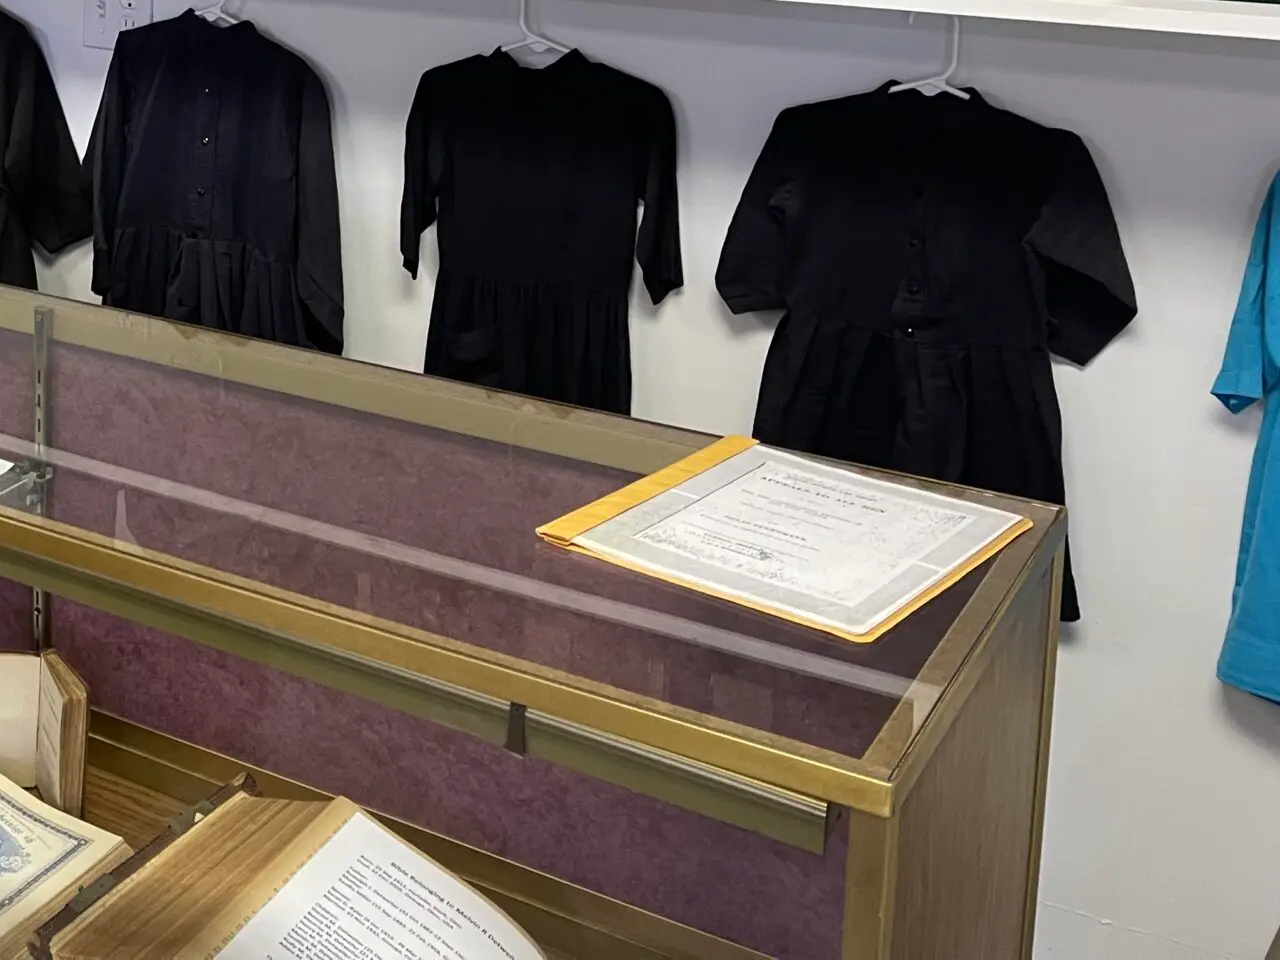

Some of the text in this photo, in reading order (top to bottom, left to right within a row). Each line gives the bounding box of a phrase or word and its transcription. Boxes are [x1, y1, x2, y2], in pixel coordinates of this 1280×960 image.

[390, 861, 409, 877] Bible
[410, 875, 445, 903] Belonging
[446, 899, 455, 909] to
